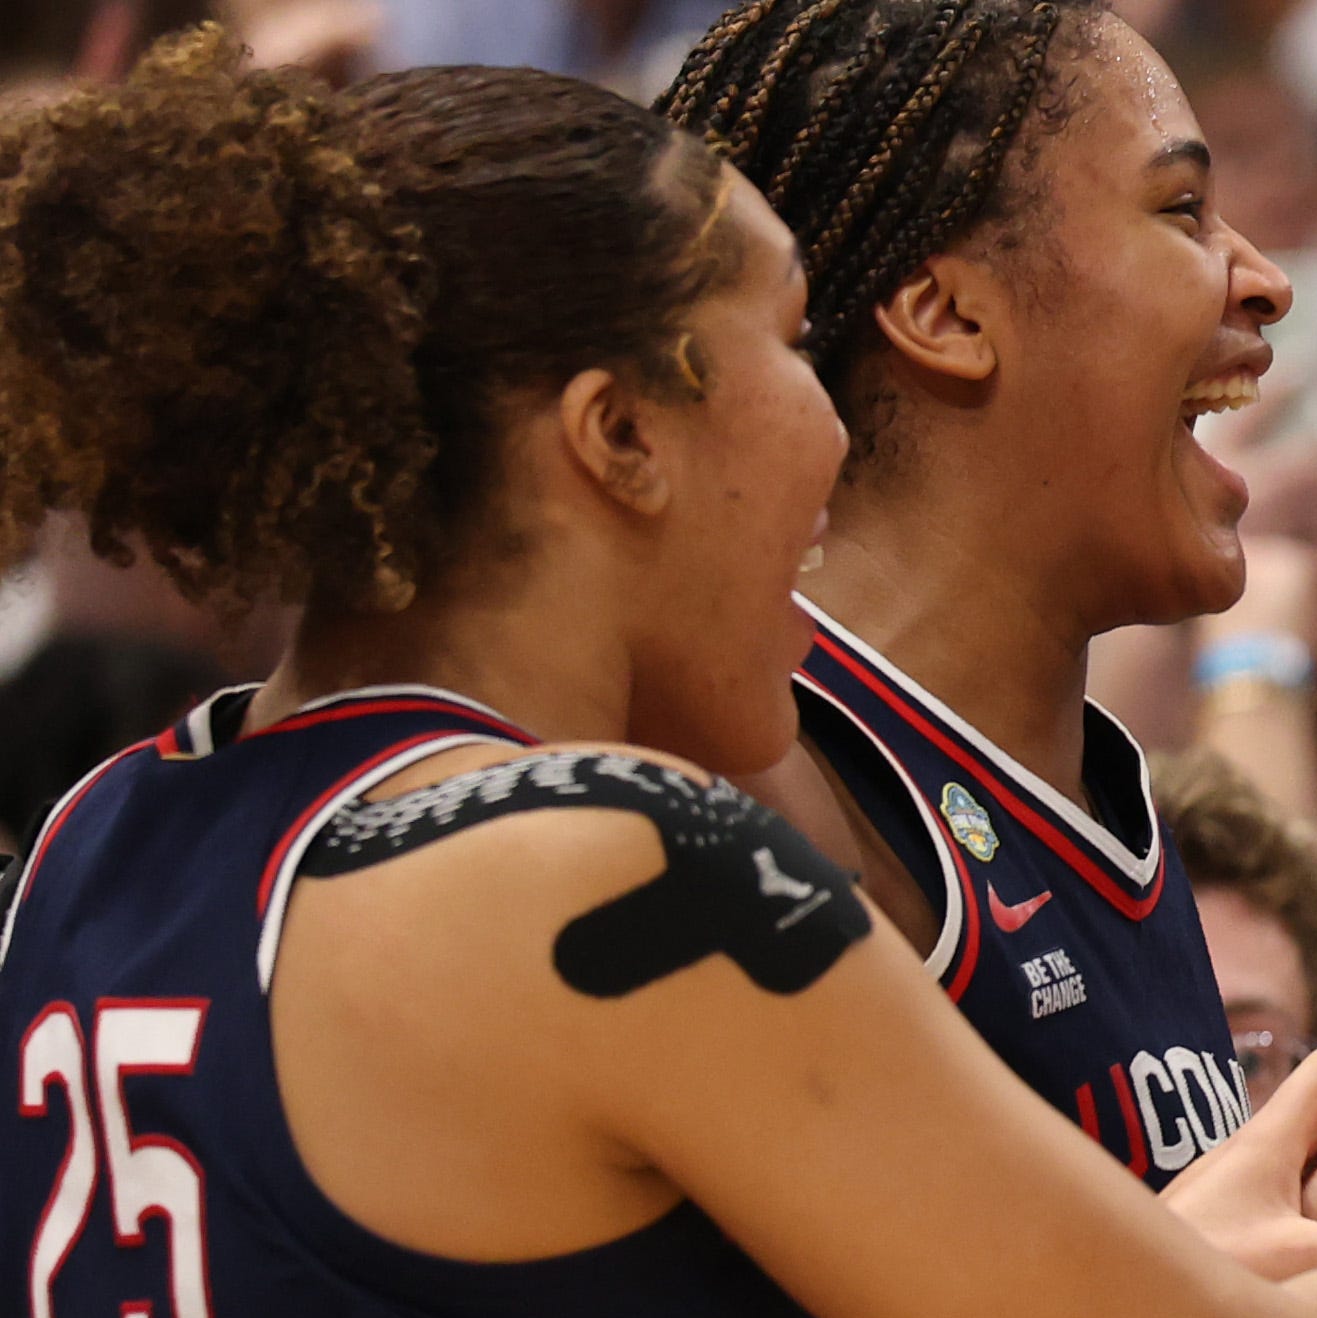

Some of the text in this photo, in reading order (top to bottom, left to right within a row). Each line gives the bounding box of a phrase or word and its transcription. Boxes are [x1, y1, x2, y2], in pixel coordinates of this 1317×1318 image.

[1020, 948, 1076, 988] BE THE
[1030, 974, 1088, 1020] CHANGE
[1075, 1046, 1252, 1180] UCON
